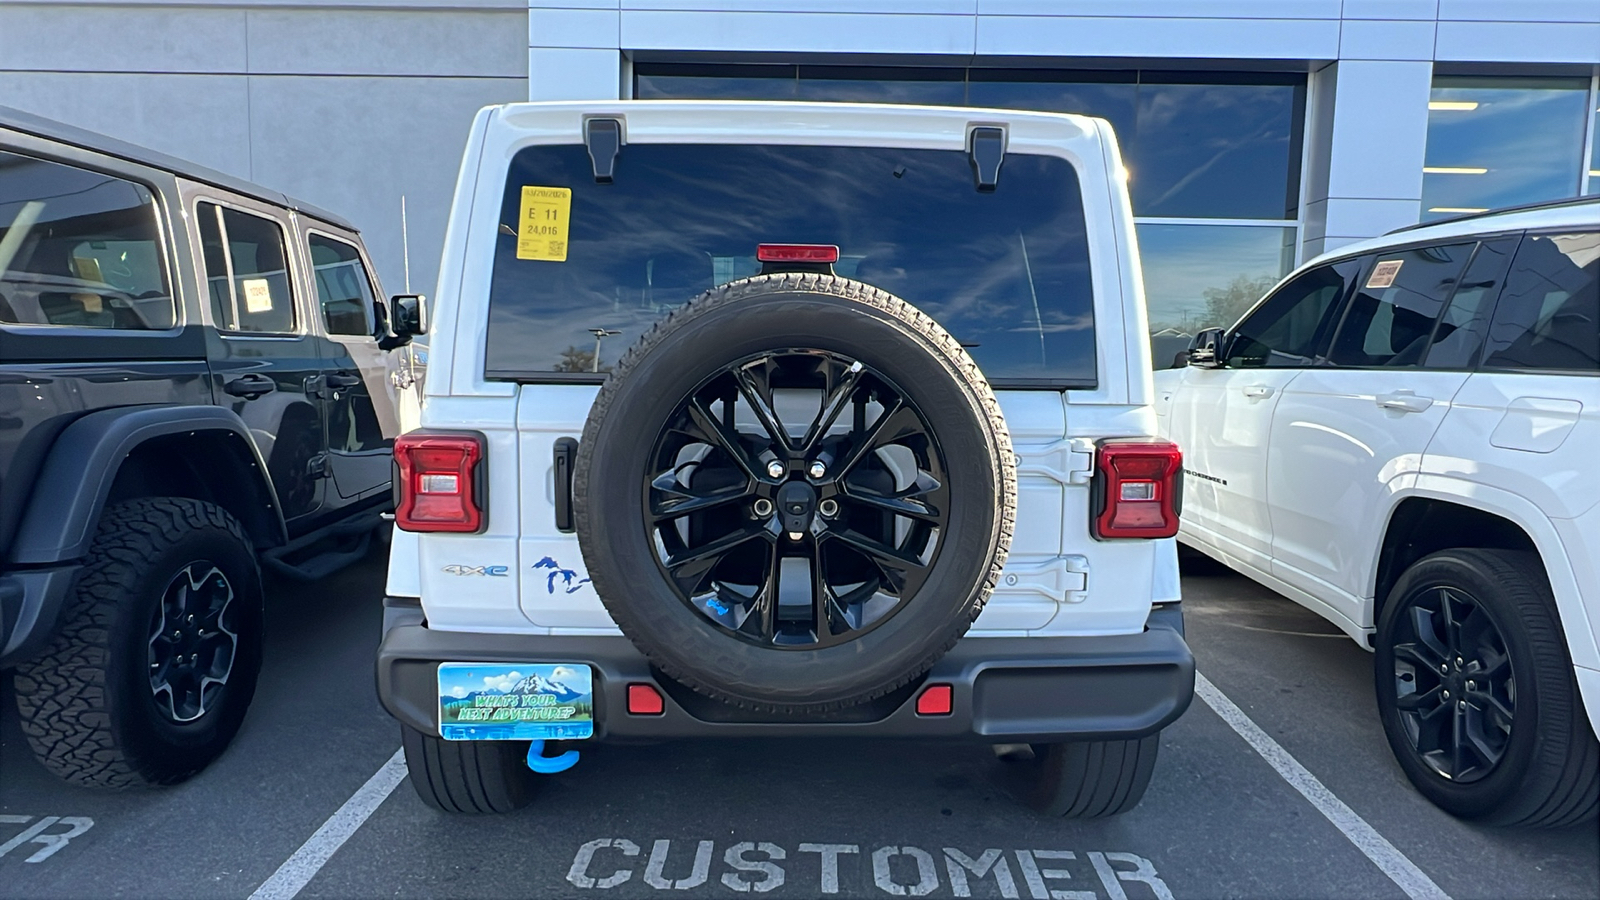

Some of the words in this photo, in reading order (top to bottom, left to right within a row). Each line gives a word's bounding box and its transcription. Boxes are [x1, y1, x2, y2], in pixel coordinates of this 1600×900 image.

[528, 207, 536, 220] E
[545, 208, 557, 221] 11
[527, 224, 558, 237] 24,016
[475, 693, 519, 708] WHAT'S
[521, 693, 557, 707] YOUR
[457, 707, 493, 721] NEXT
[492, 706, 576, 720] ADVENTURE?
[566, 838, 1174, 900] CUSTOMER
